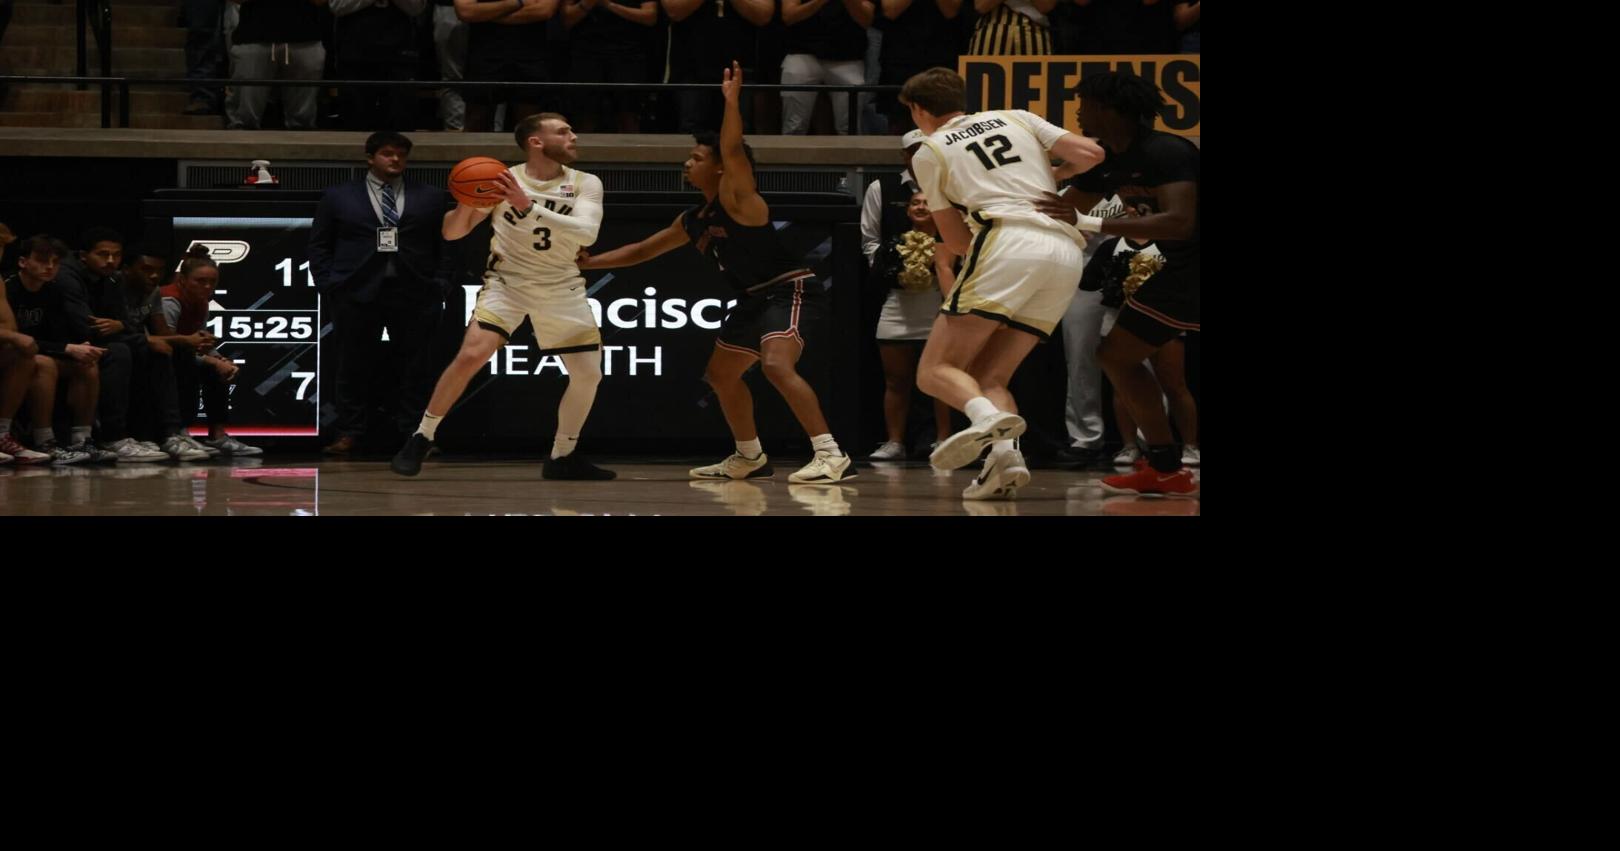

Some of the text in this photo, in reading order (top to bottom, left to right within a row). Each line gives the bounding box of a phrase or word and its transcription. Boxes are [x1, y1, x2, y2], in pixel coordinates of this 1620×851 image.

[966, 60, 1199, 130] DEFS
[945, 118, 1007, 146] JACOBSEN
[966, 134, 1021, 171] 12
[533, 227, 551, 250] 3
[274, 258, 316, 287] 11
[206, 316, 312, 339] 15:25
[485, 345, 662, 376] HEATH
[291, 372, 316, 400] 7
